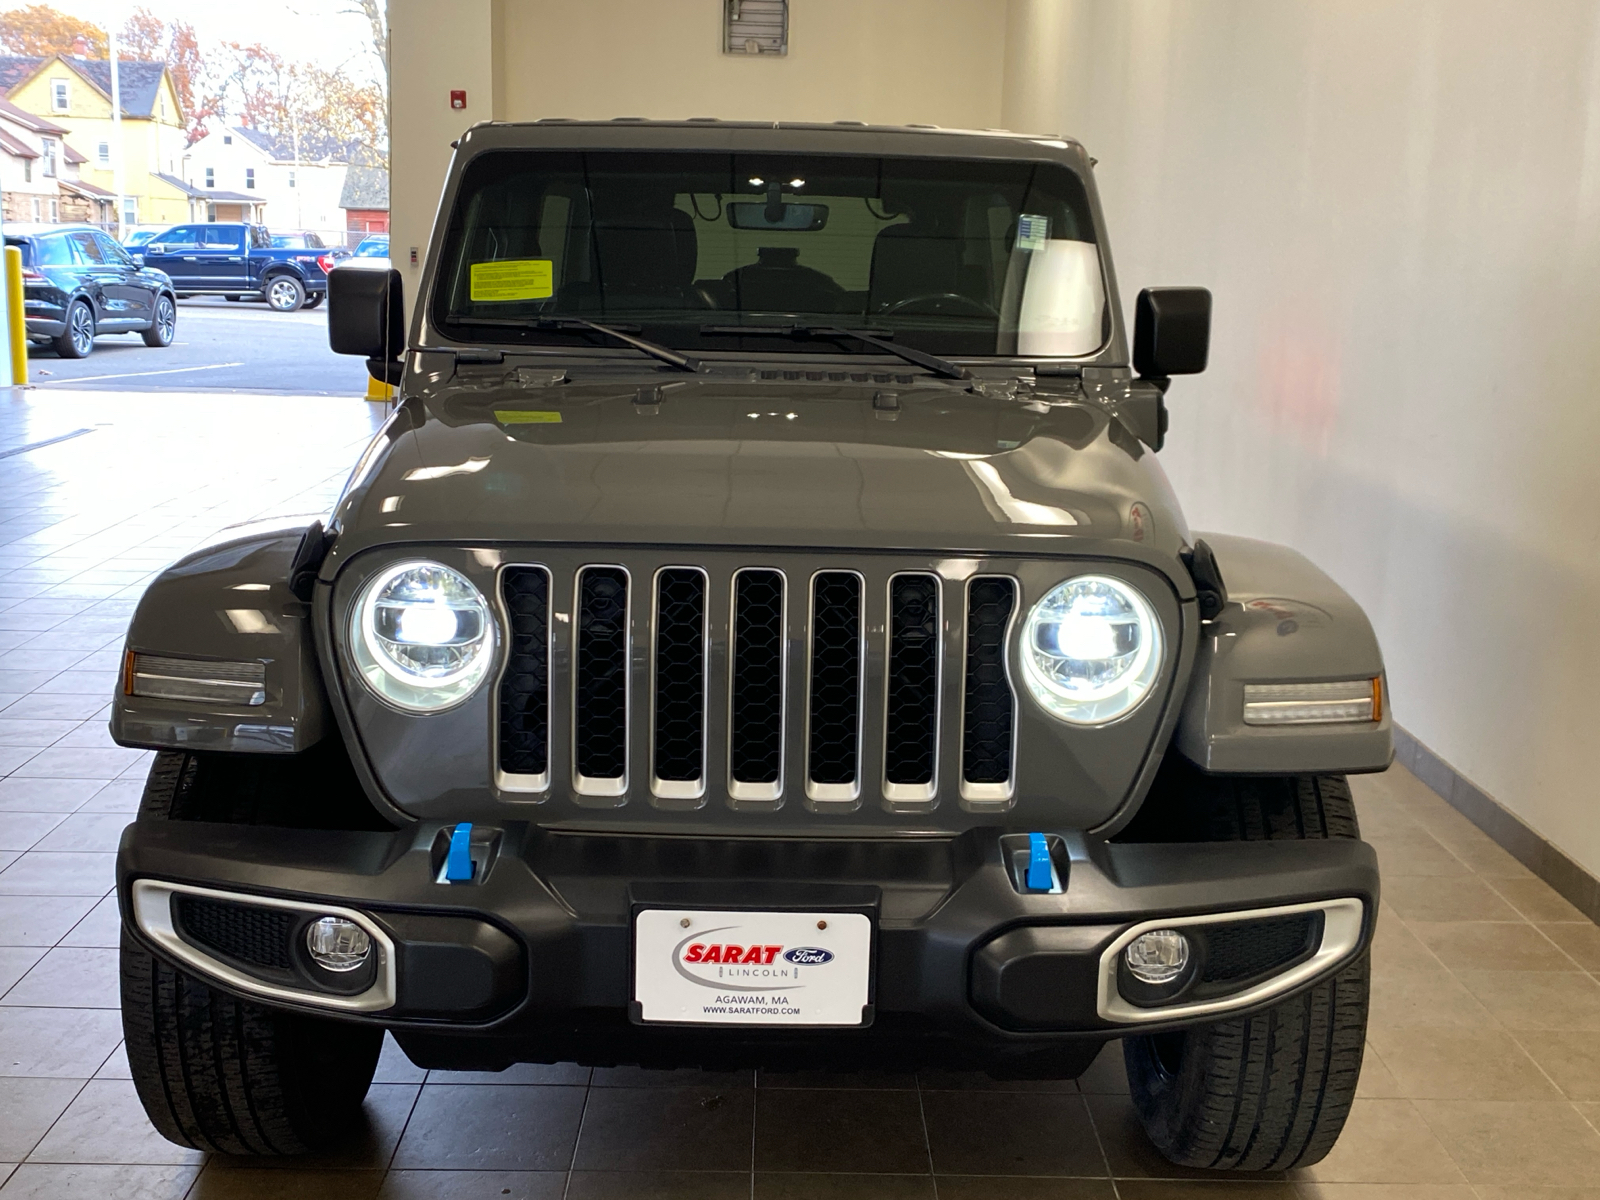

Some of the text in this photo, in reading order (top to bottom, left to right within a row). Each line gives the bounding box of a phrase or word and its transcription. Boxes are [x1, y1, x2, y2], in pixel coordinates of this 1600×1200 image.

[683, 943, 826, 966] SARAT Ford
[728, 968, 788, 978] LINCOLN
[715, 995, 789, 1006] AGAWAM, MA
[703, 1006, 800, 1015] WWW.SARATFORD.COM
